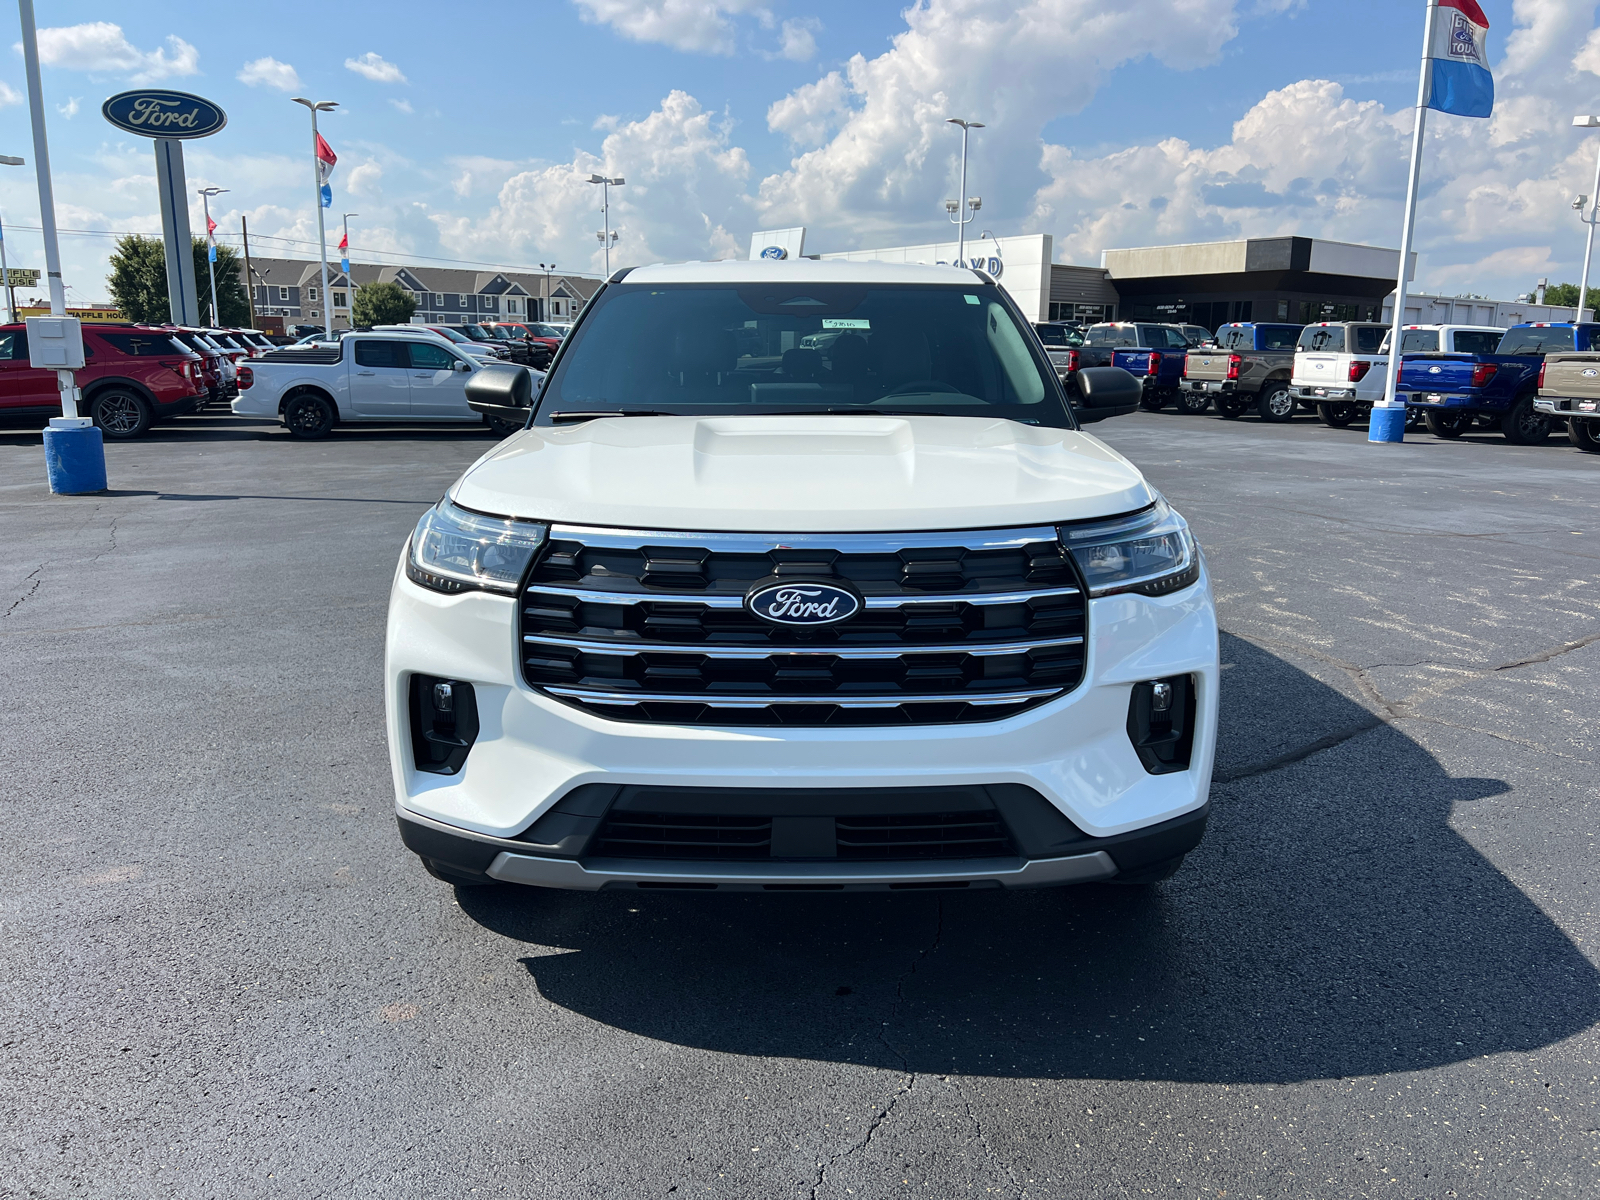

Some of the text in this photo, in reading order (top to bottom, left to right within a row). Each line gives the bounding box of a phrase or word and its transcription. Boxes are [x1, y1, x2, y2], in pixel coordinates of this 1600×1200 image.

[1451, 42, 1477, 55] TOU
[128, 97, 199, 128] Ford
[936, 257, 1004, 277] YD
[106, 312, 128, 320] HOU
[768, 588, 839, 618] Ford
